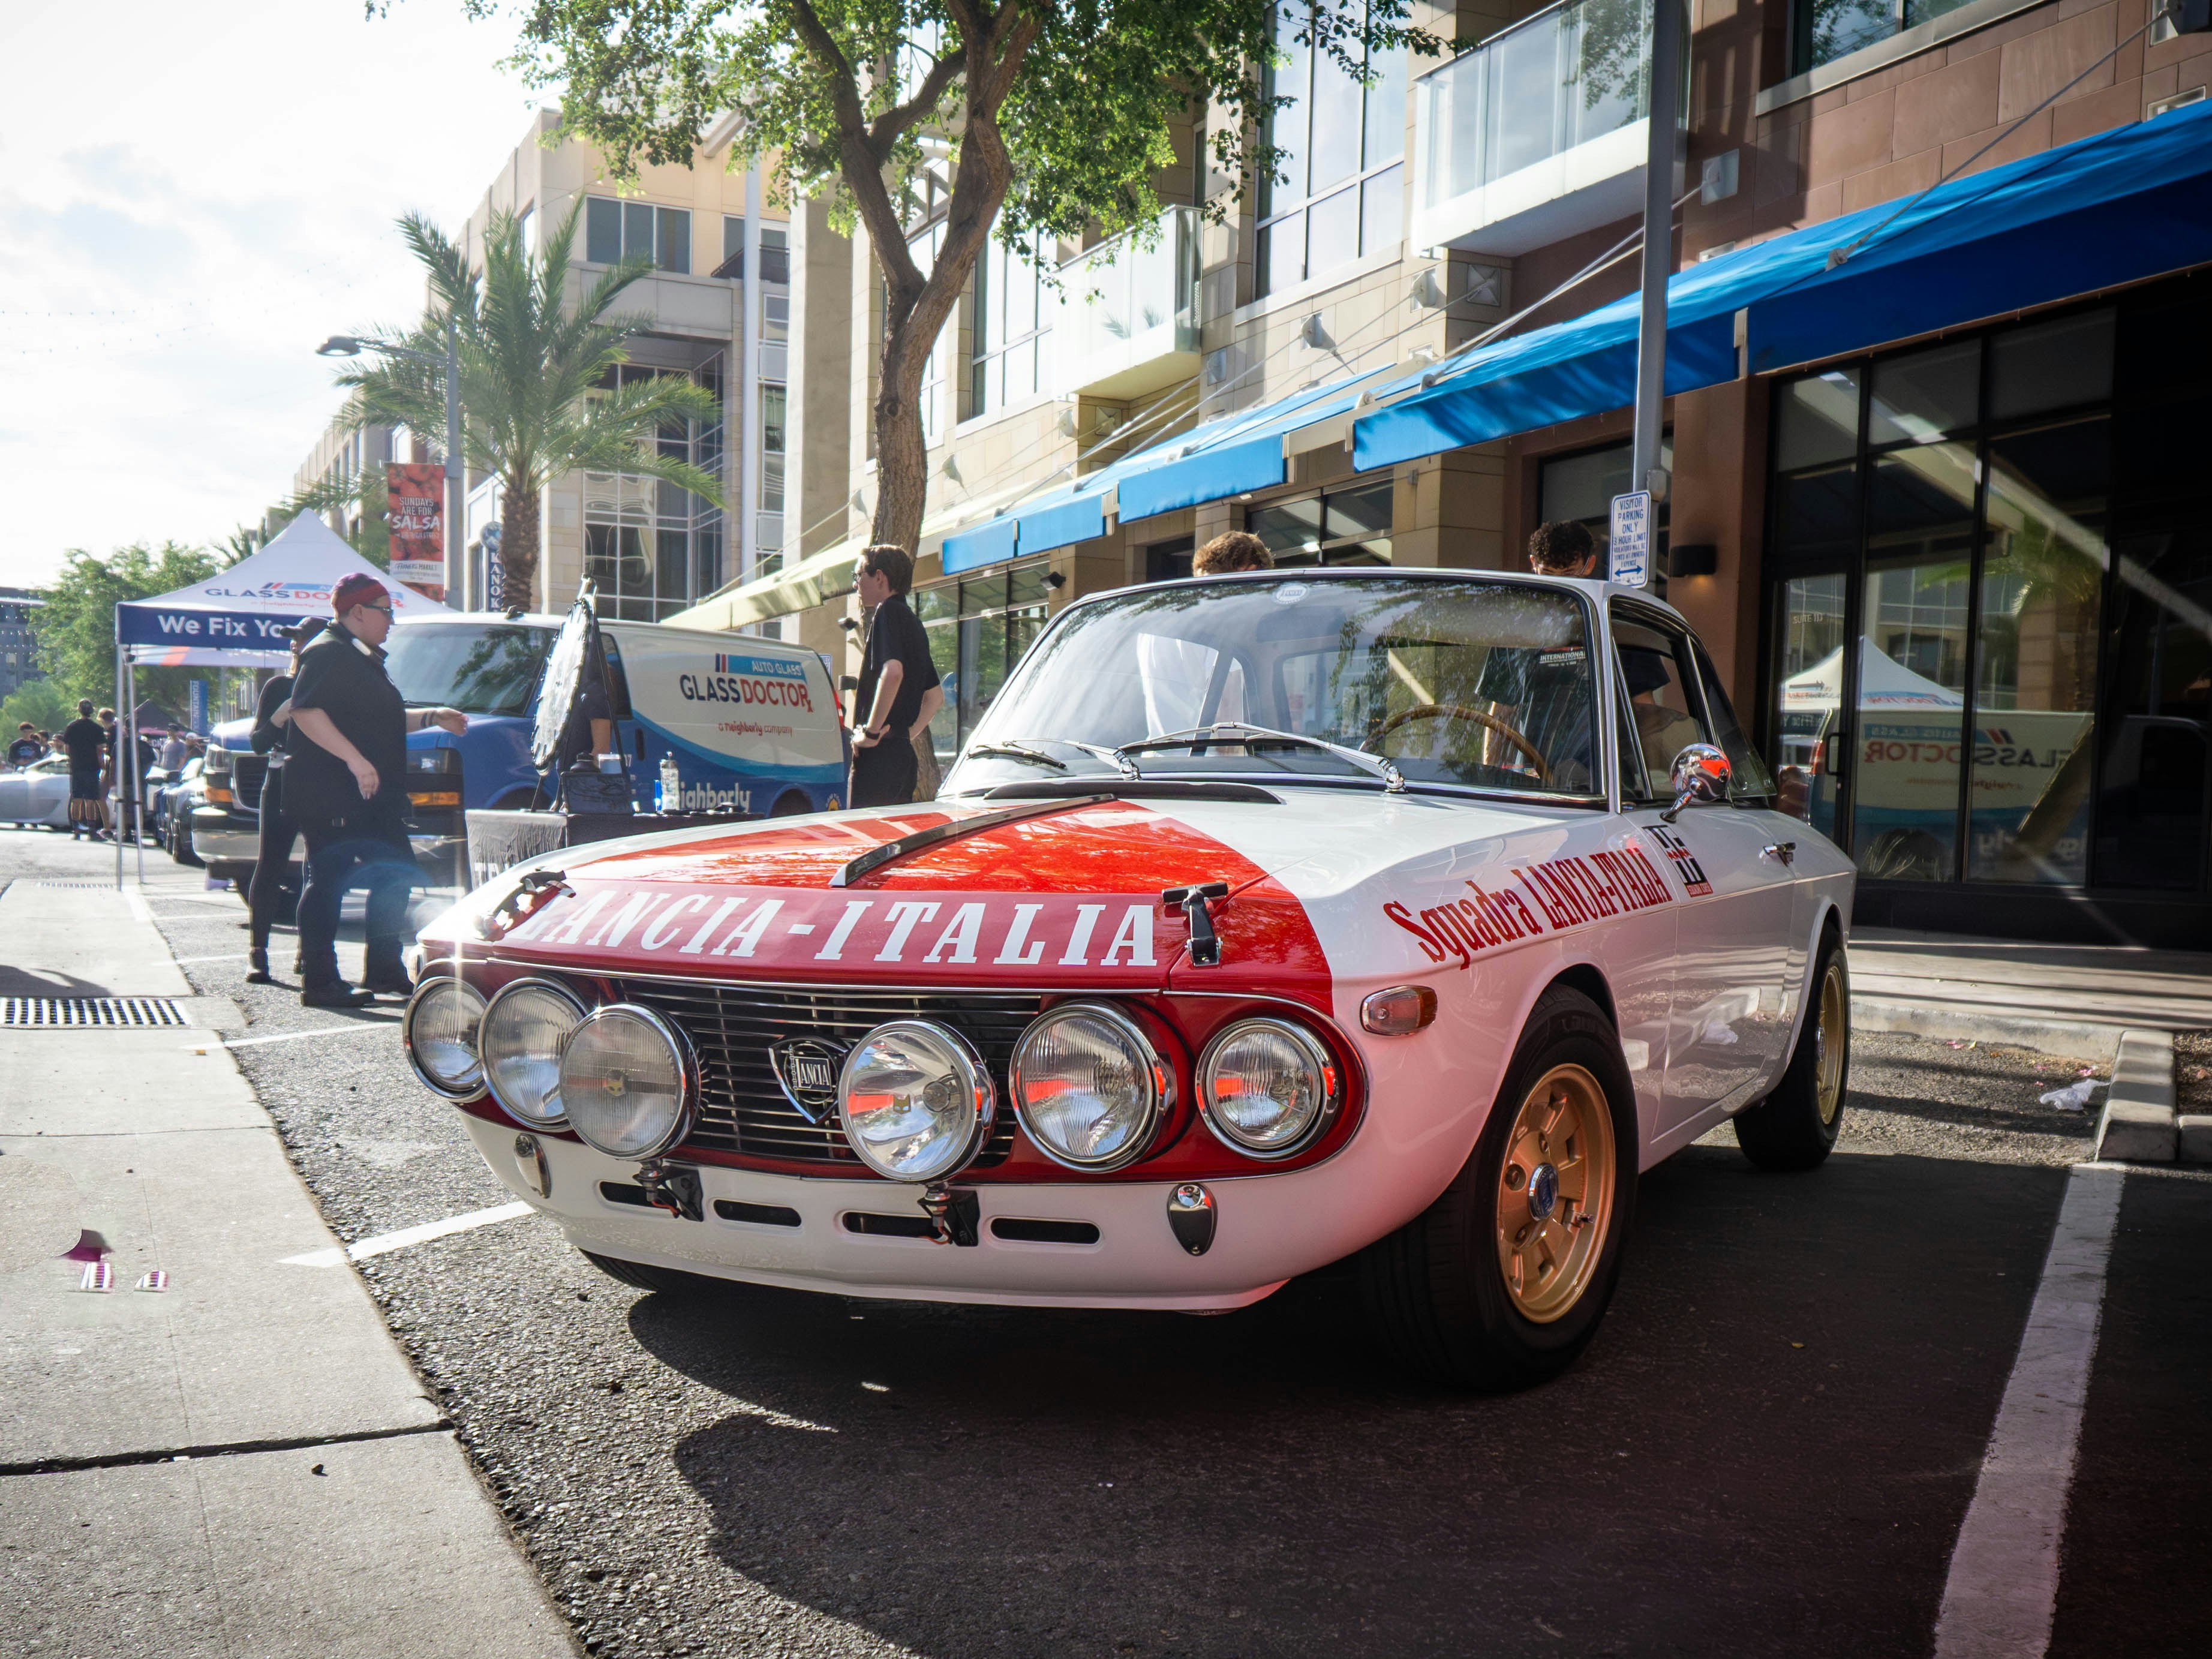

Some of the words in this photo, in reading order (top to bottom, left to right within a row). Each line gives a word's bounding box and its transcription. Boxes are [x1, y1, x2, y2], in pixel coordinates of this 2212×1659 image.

[399, 497, 434, 507] SUNDAYS
[1620, 497, 1643, 510] VISITOR
[401, 506, 416, 515] ARE
[418, 507, 432, 516] FOR
[1618, 509, 1643, 522] PARKING
[392, 515, 440, 531] SALSA
[1622, 522, 1638, 533] ONLY
[1619, 535, 1631, 545] HOUR
[1633, 532, 1646, 542] LIMIT
[490, 552, 501, 611] KANOK
[157, 615, 202, 635] We
[209, 617, 248, 637] Fix
[255, 618, 290, 638] Yo
[1793, 614, 1811, 624] SUITE
[752, 660, 773, 673] AUTO
[775, 663, 802, 675] GLASS
[725, 721, 762, 736] neighborly
[764, 725, 792, 737] company
[681, 782, 752, 813] ighborly
[1383, 879, 1544, 970] Squadra
[795, 1058, 830, 1089] LANCIA
